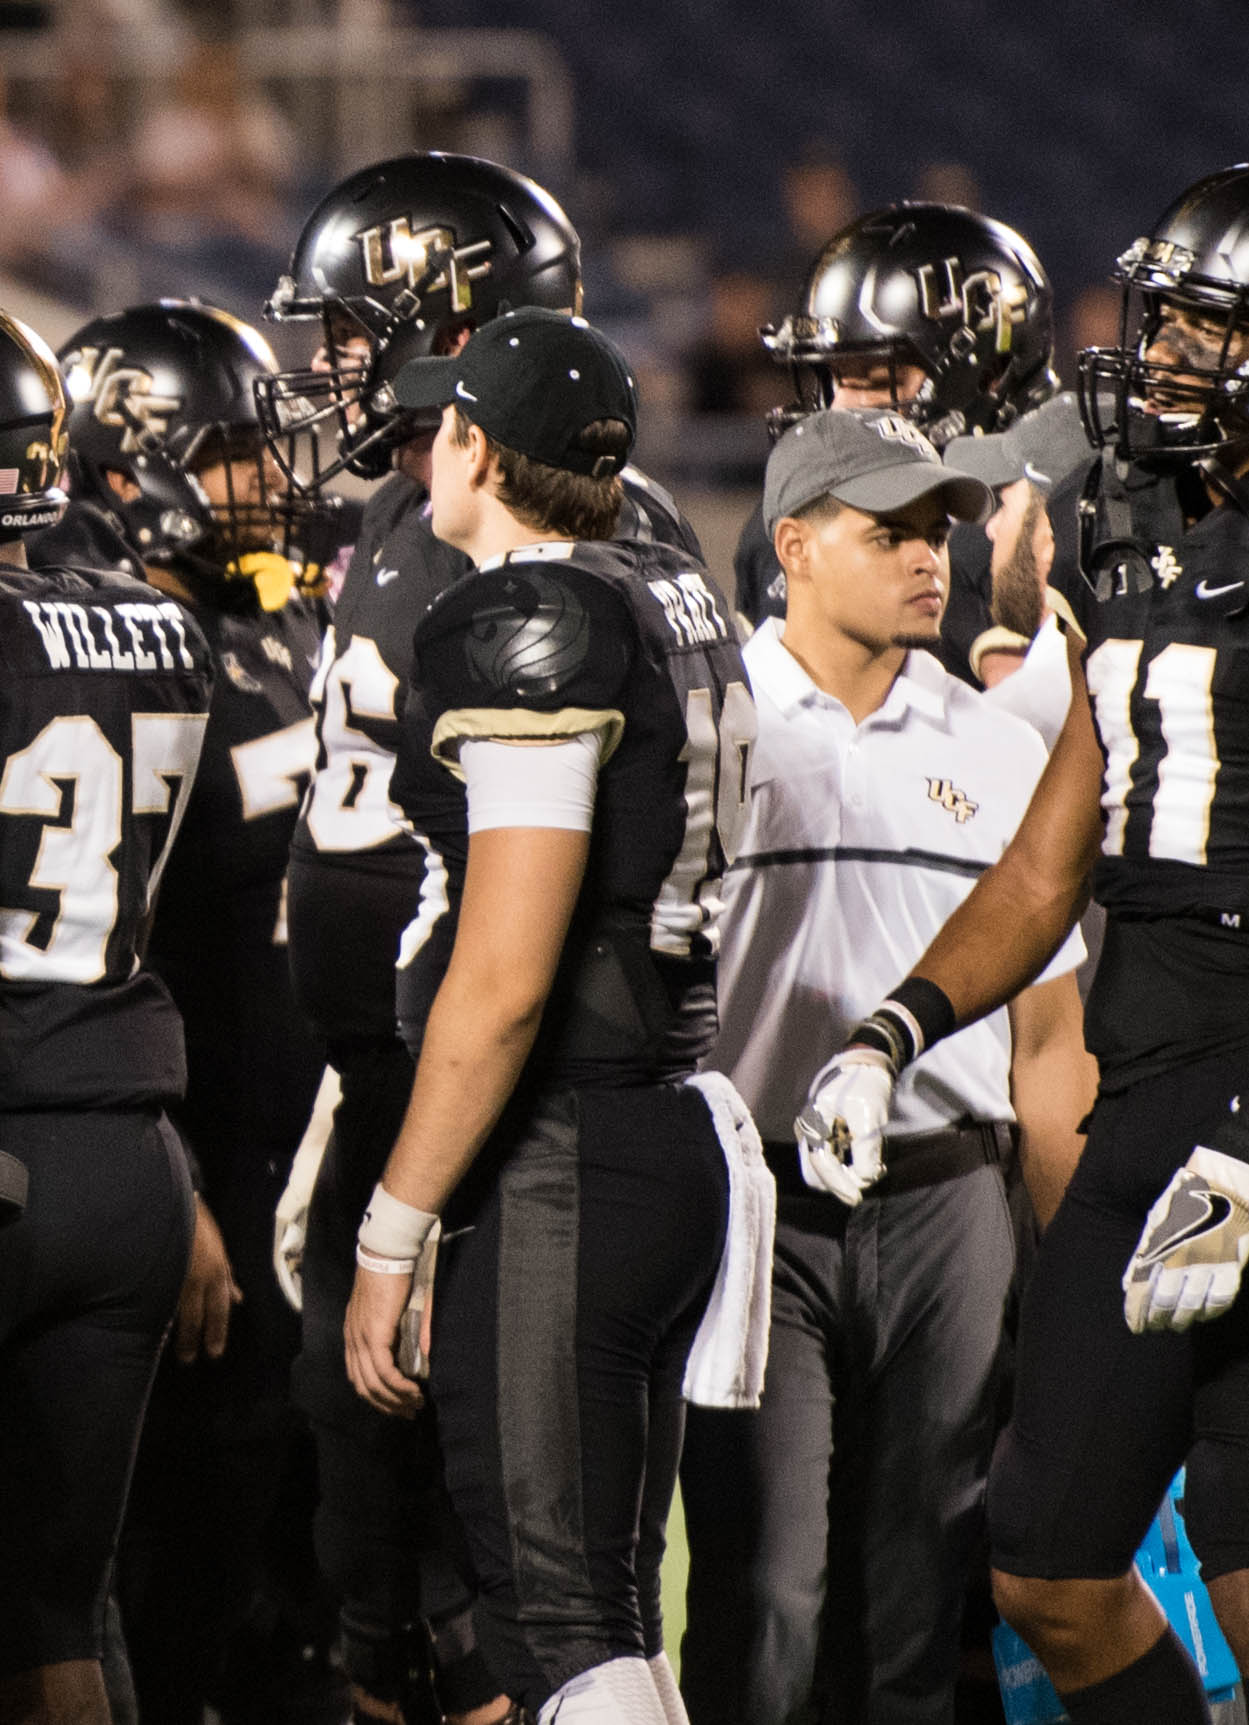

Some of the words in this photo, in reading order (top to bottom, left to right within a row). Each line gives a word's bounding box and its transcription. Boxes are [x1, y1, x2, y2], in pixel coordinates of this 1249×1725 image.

[355, 217, 491, 313] UCF
[917, 256, 1029, 353] UCF
[23, 600, 194, 671] WILLETT
[924, 776, 979, 824] UCF
[1085, 638, 1221, 866] 11
